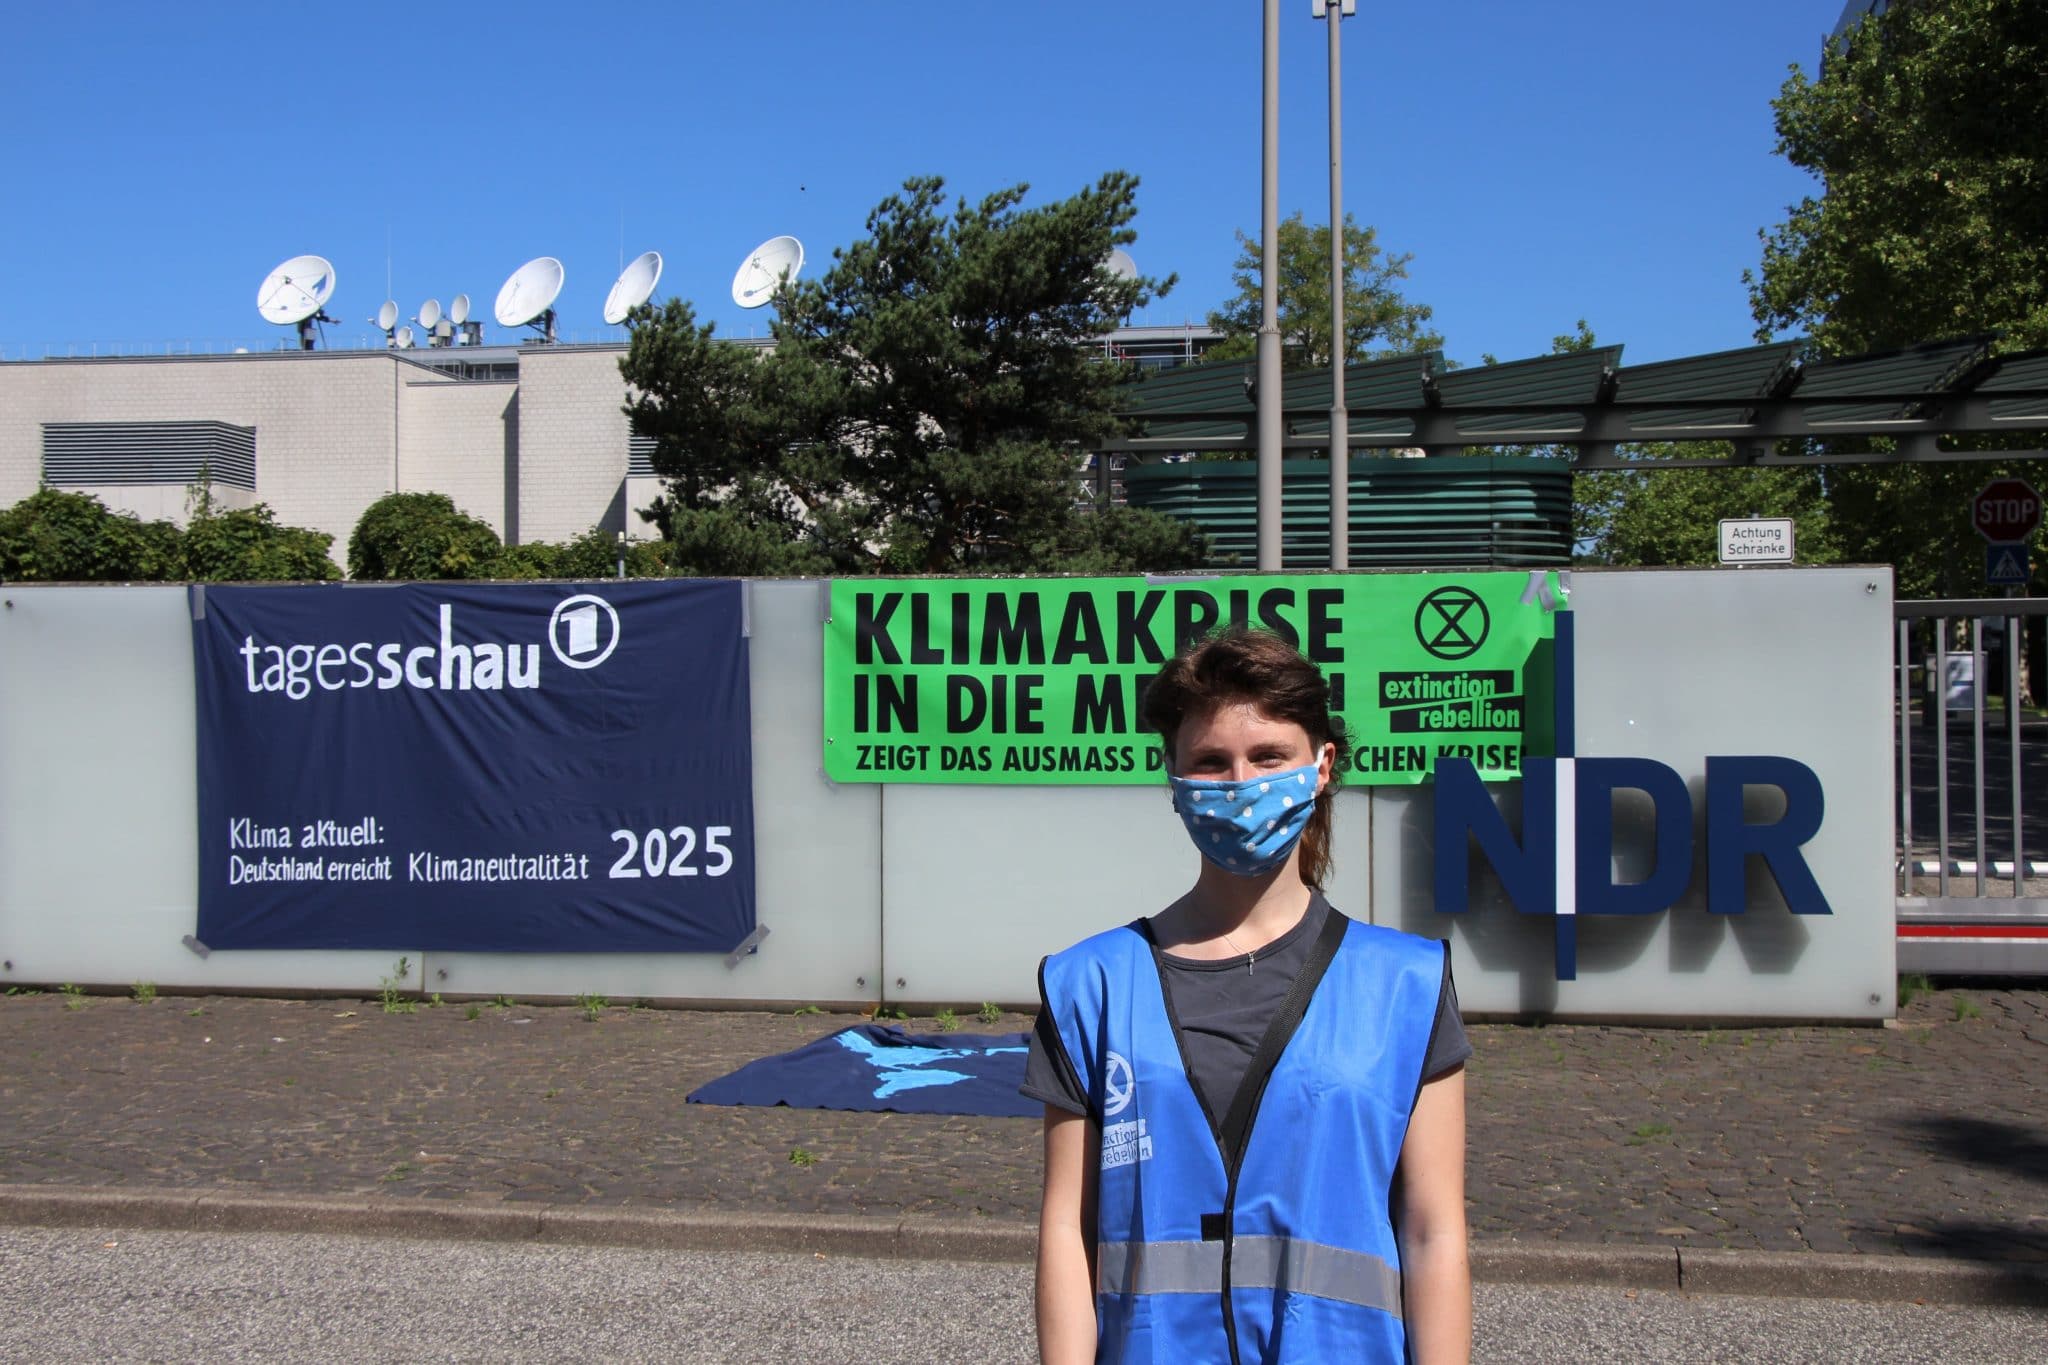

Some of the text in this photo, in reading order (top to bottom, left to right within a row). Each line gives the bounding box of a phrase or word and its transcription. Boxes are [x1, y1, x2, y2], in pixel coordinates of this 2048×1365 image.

[1980, 498, 2036, 524] STOP
[1732, 527, 1781, 540] Achtung
[854, 588, 1345, 665] KLIMAKRISE
[239, 603, 540, 700] tagesschau
[1384, 673, 1496, 699] extinction
[853, 673, 919, 734] IN
[946, 674, 1045, 734] DIE
[1419, 700, 1520, 729] rebellion
[856, 744, 931, 771] ZEIGT
[940, 745, 993, 772] DAS
[1002, 745, 1135, 772] AUSMASS
[230, 817, 293, 849] Klima
[1434, 756, 1834, 915] NDR
[230, 825, 733, 885] Deutschland erreicht Klimaneutralität 2025
